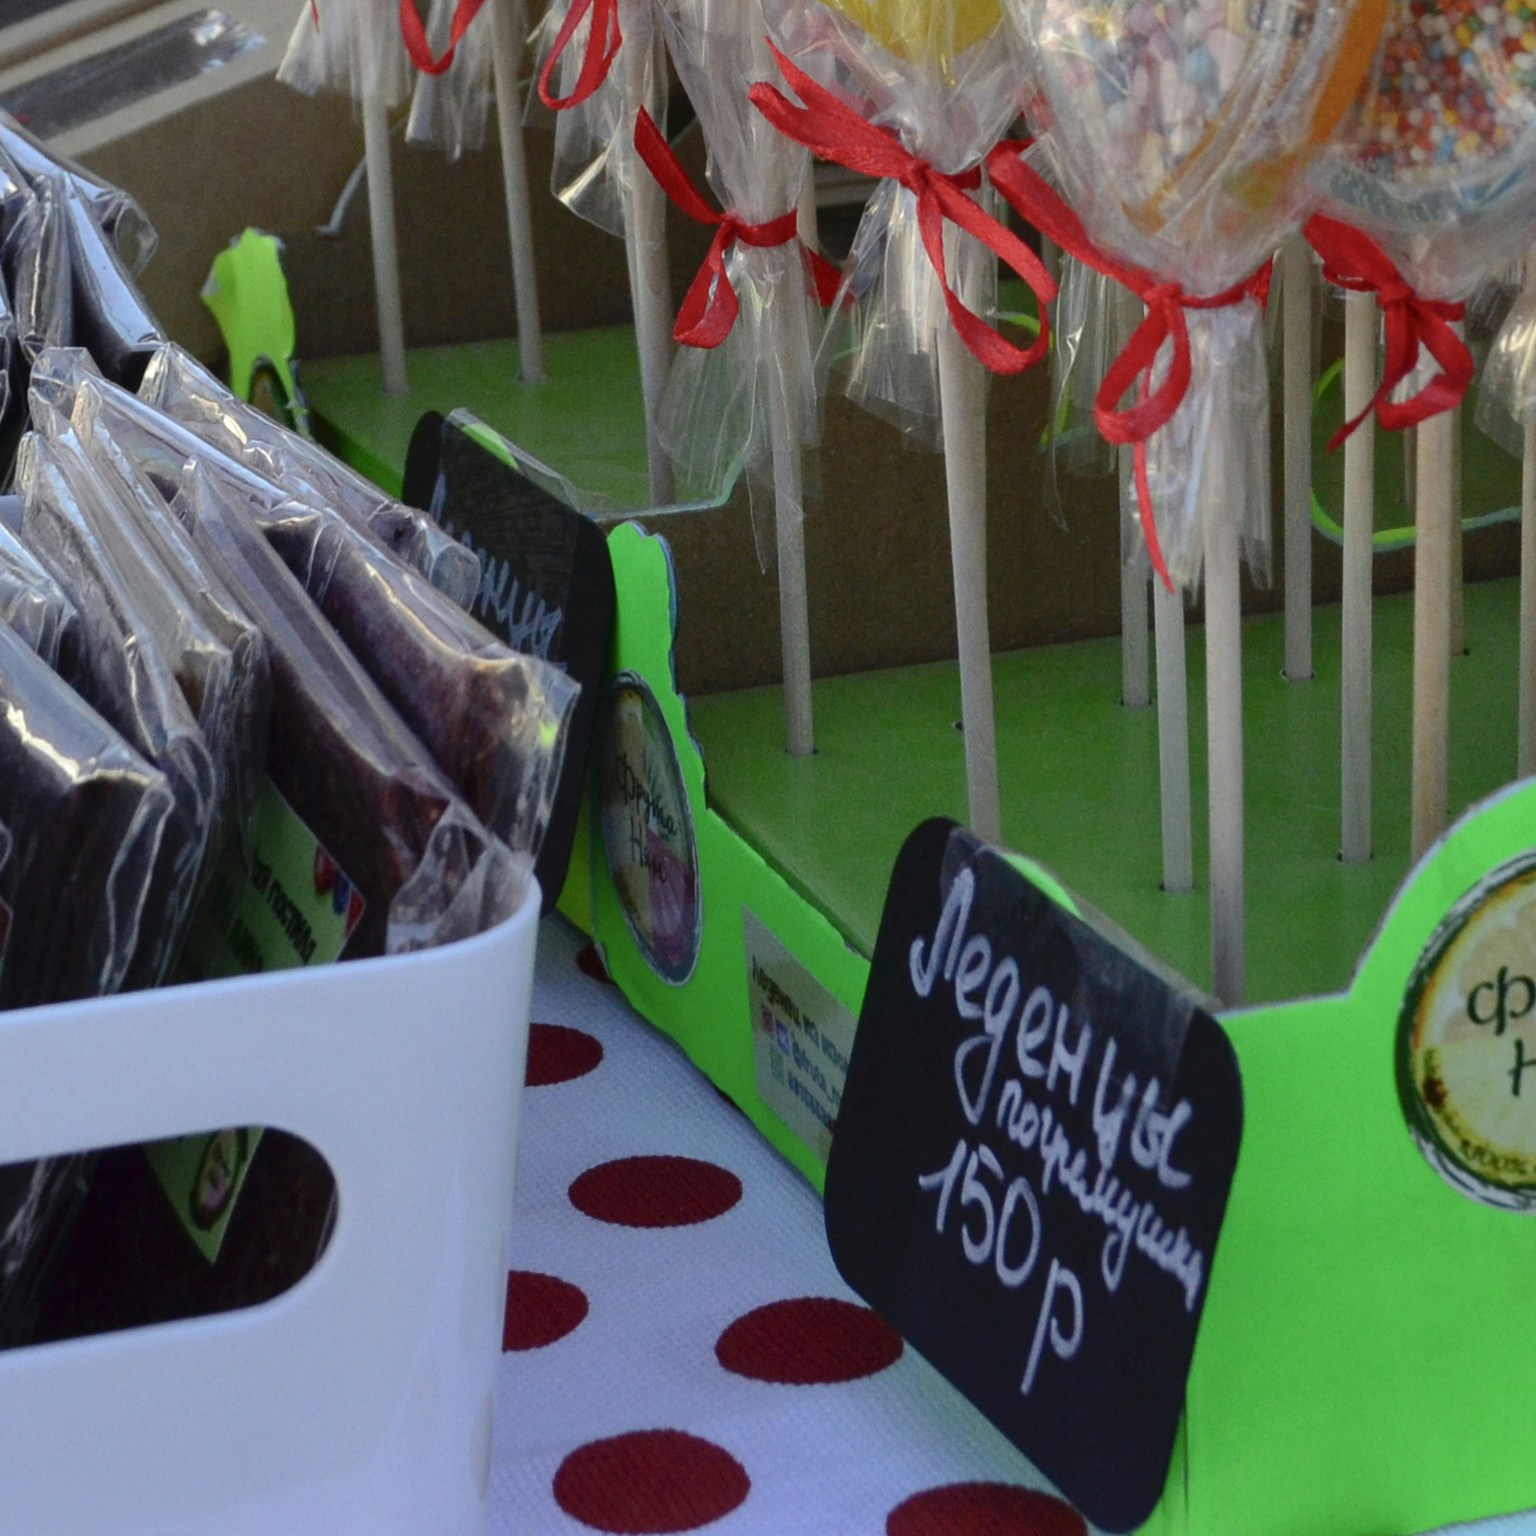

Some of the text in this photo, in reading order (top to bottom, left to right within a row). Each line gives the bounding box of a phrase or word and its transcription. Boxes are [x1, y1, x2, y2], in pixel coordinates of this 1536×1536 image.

[908, 866, 1194, 1190] Леденцы
[917, 1137, 1085, 1396] 150 р
